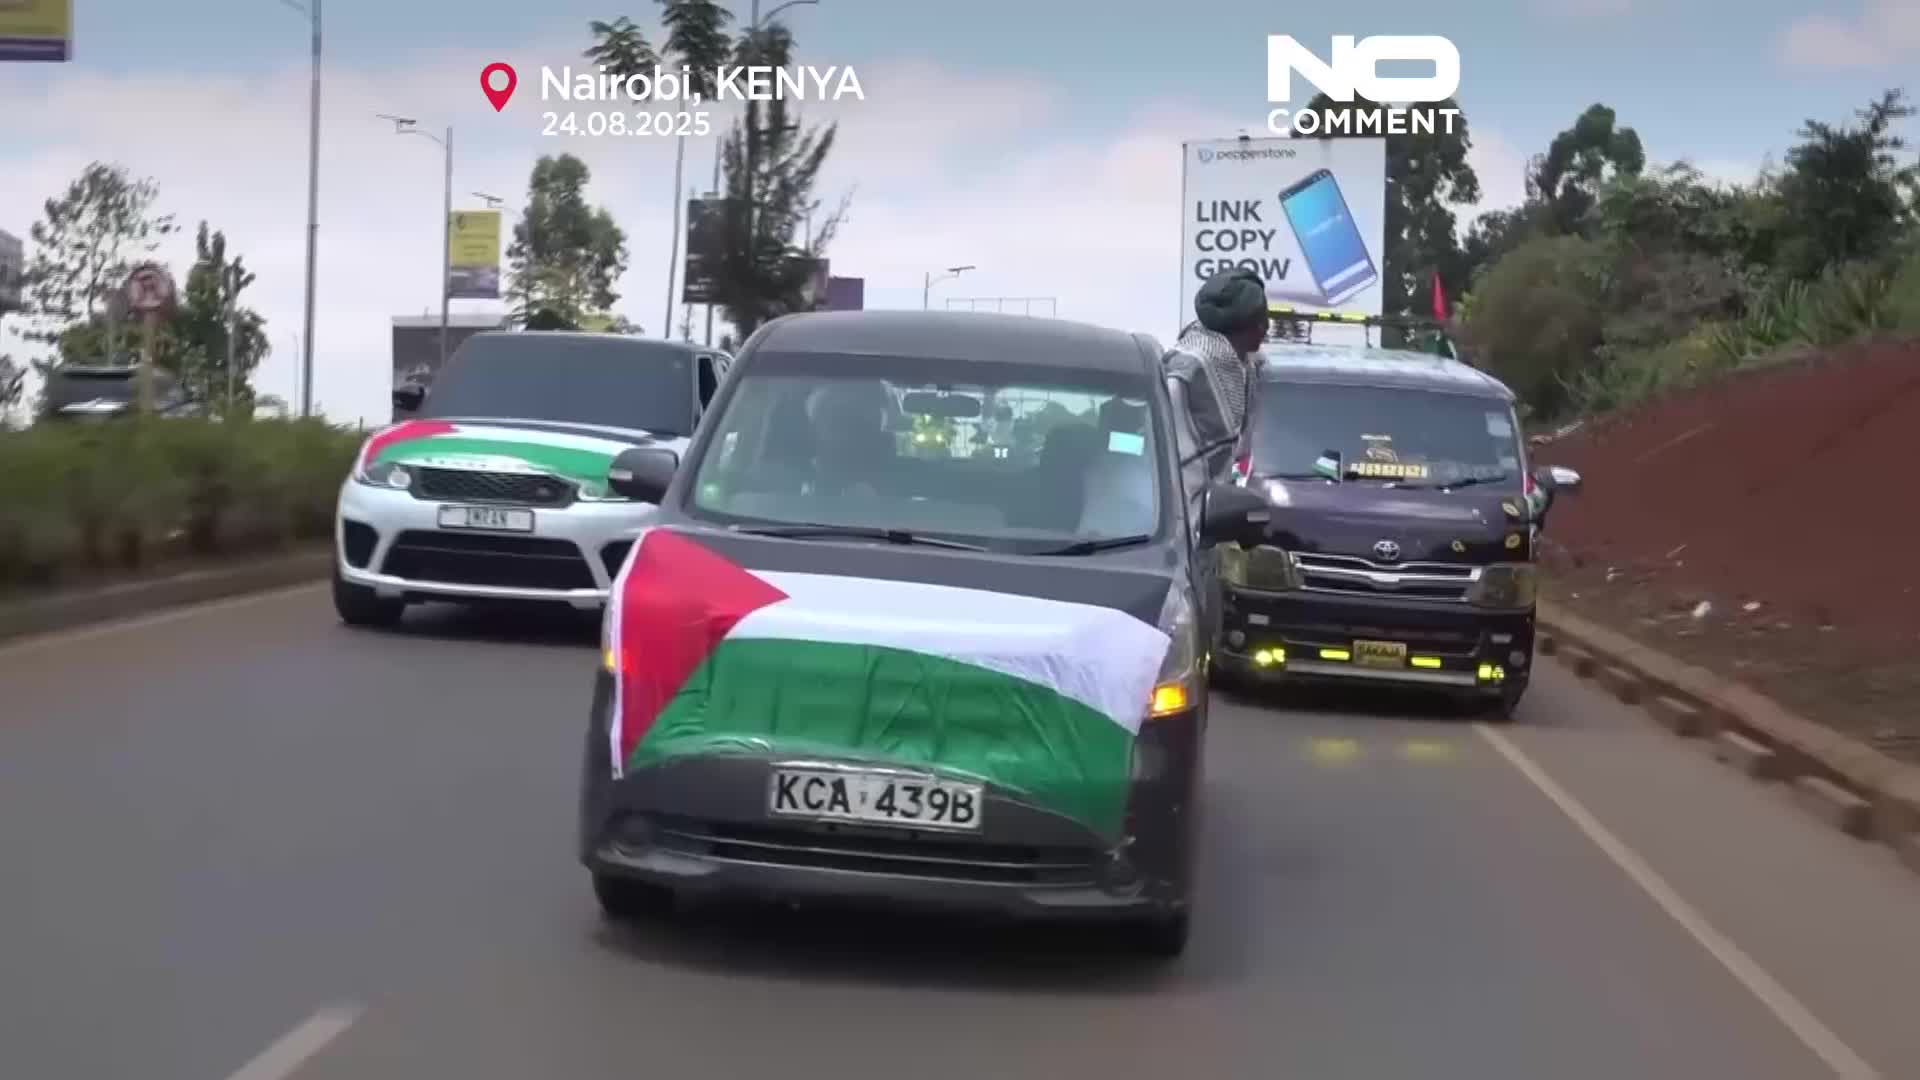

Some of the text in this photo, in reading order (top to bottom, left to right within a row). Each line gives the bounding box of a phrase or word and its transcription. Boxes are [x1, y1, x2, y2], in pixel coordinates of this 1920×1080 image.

[1216, 149, 1296, 163] pepperstone
[1197, 200, 1262, 222] LINK
[1195, 229, 1276, 252] COPY
[775, 774, 974, 823] KCA 439B
